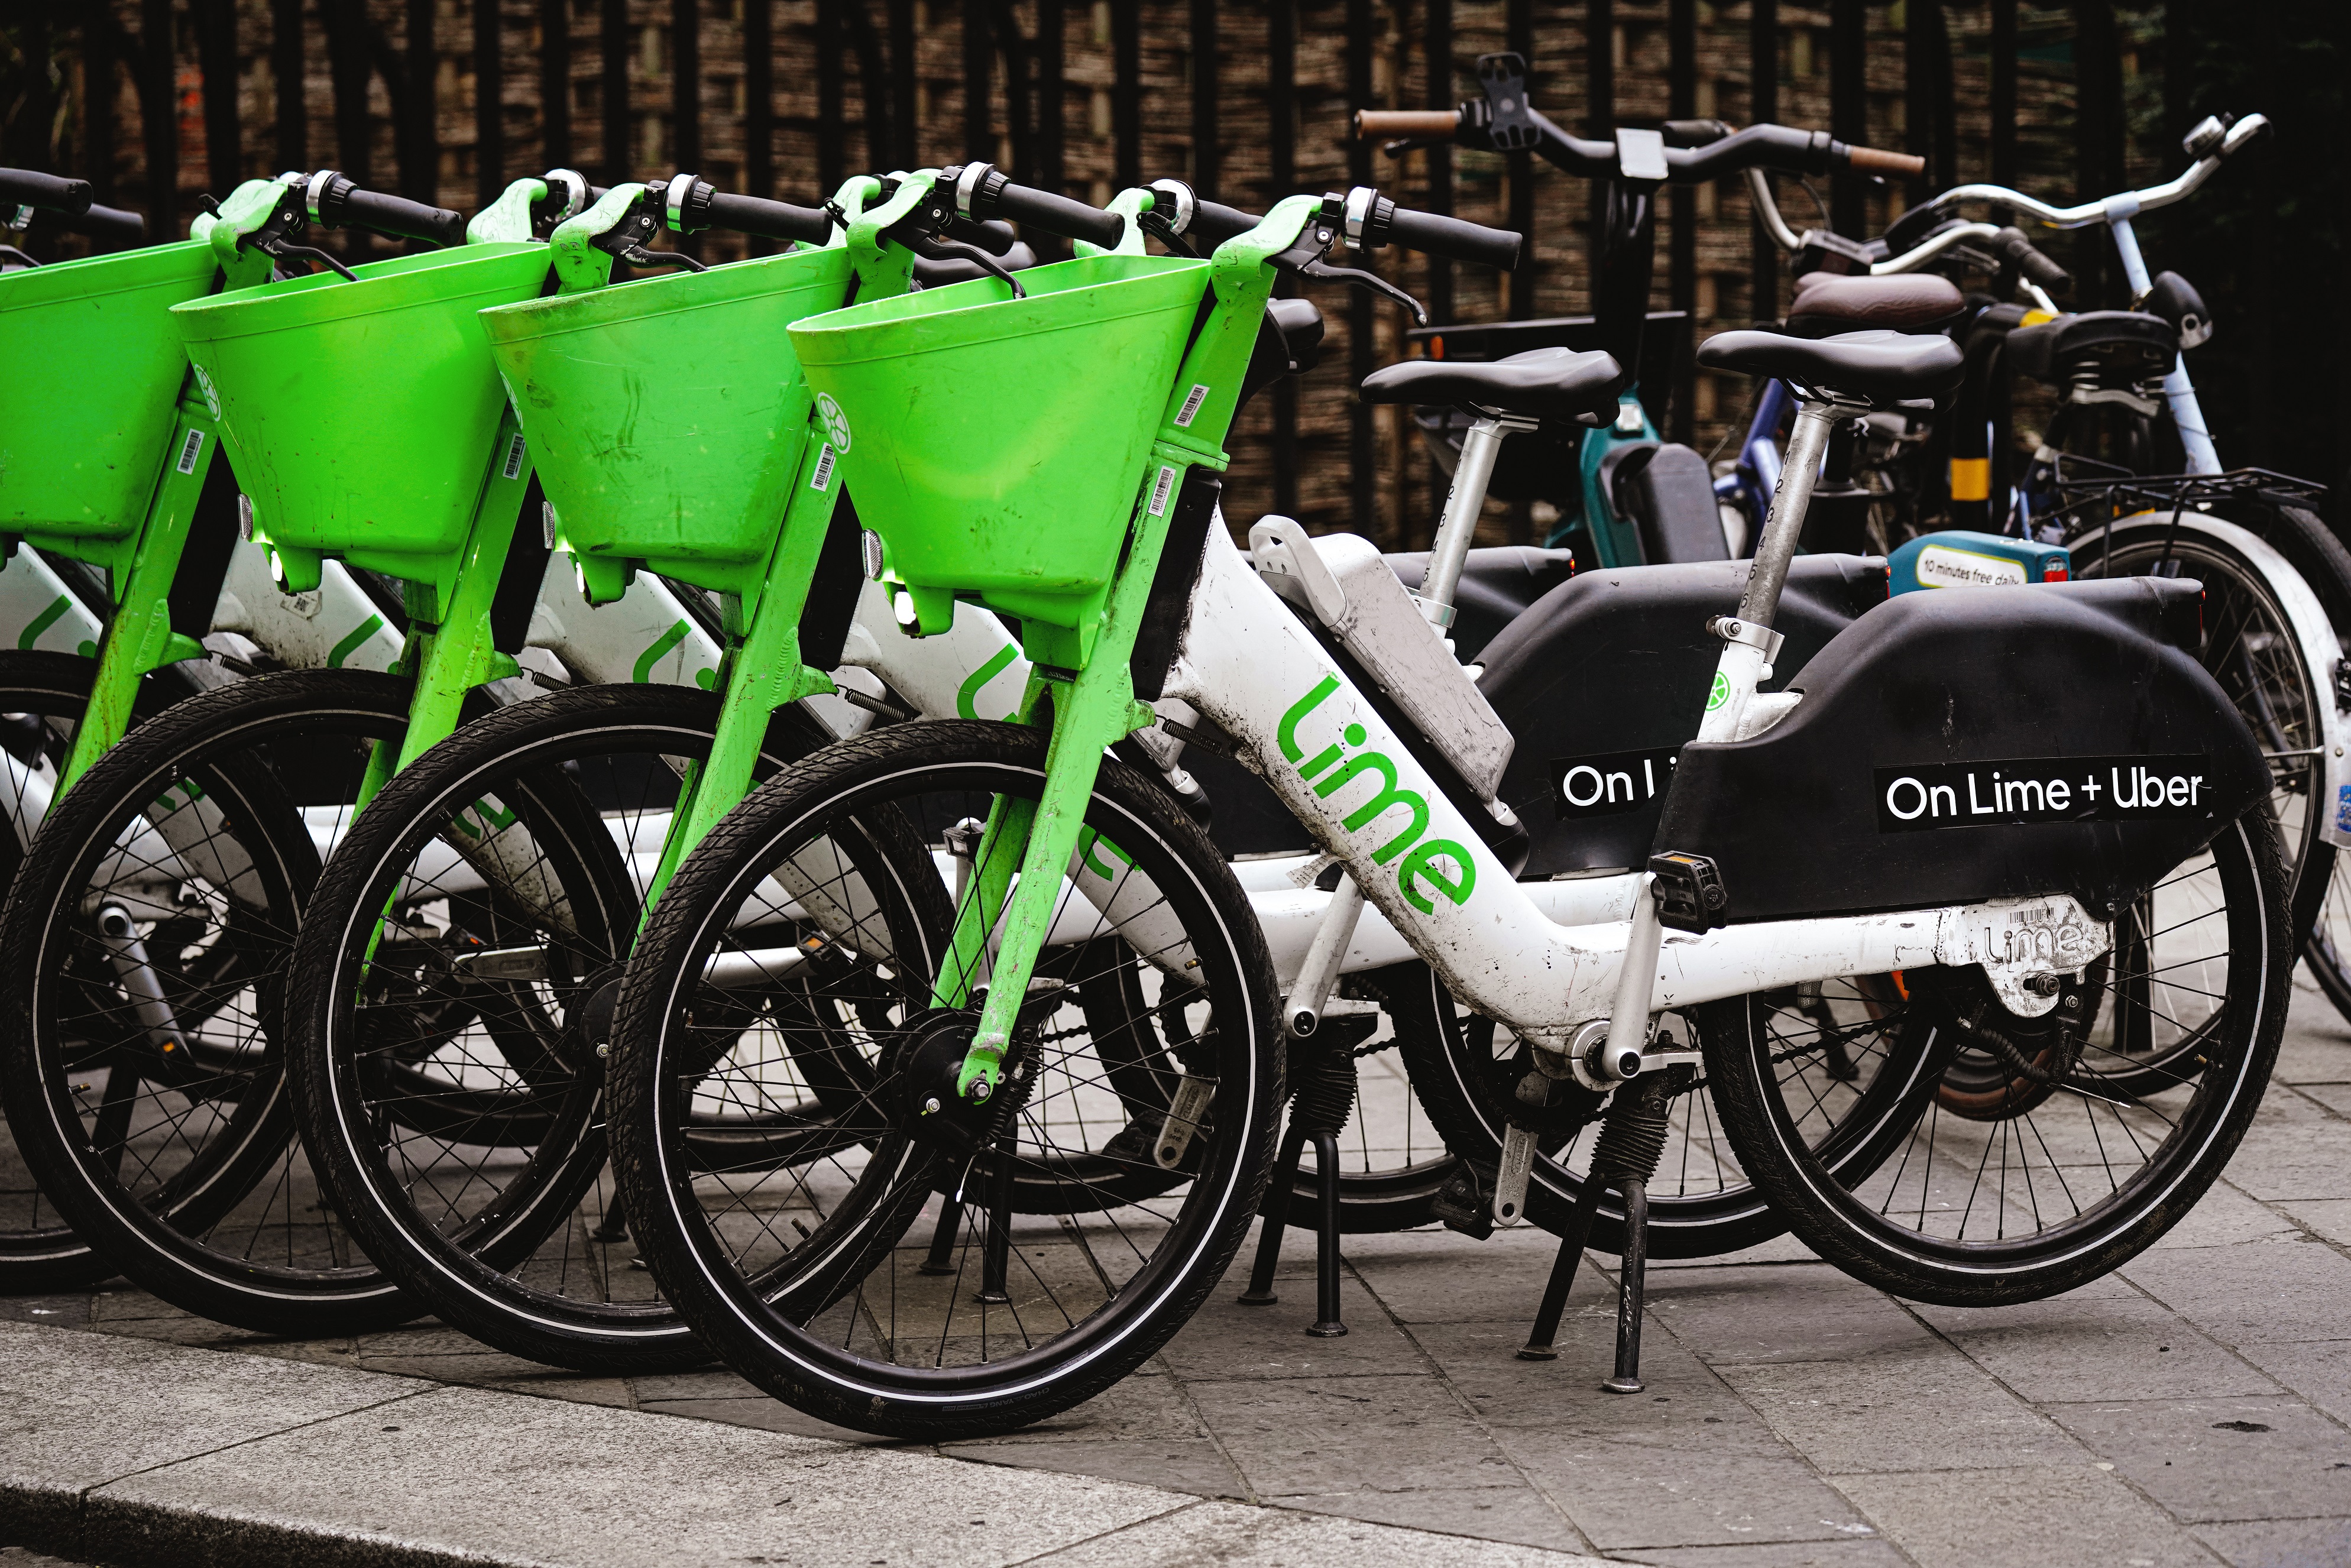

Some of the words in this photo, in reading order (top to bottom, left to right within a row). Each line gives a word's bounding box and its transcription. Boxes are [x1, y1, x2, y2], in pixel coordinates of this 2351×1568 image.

[1456, 458, 1462, 472] 1
[1784, 451, 1790, 465] 1
[1447, 485, 1455, 500] 2
[1774, 478, 1784, 494] 2
[1439, 513, 1446, 527] 3
[1766, 507, 1774, 523] 3
[1432, 540, 1439, 554] 4
[1758, 536, 1766, 550] 4
[1423, 568, 1430, 582] 5
[1749, 564, 1759, 581] 5
[1925, 559, 1935, 572] 10
[1936, 562, 1970, 580] minutes
[1973, 568, 1992, 584] free
[1741, 592, 1749, 609] 6
[1563, 765, 1634, 806] On
[1886, 777, 1957, 820] On
[1968, 772, 2071, 814] Lime
[2081, 775, 2101, 801] +
[2112, 766, 2203, 808] Uber
[1025, 1387, 1050, 1399] CHAO
[989, 1400, 1015, 1408] YANG
